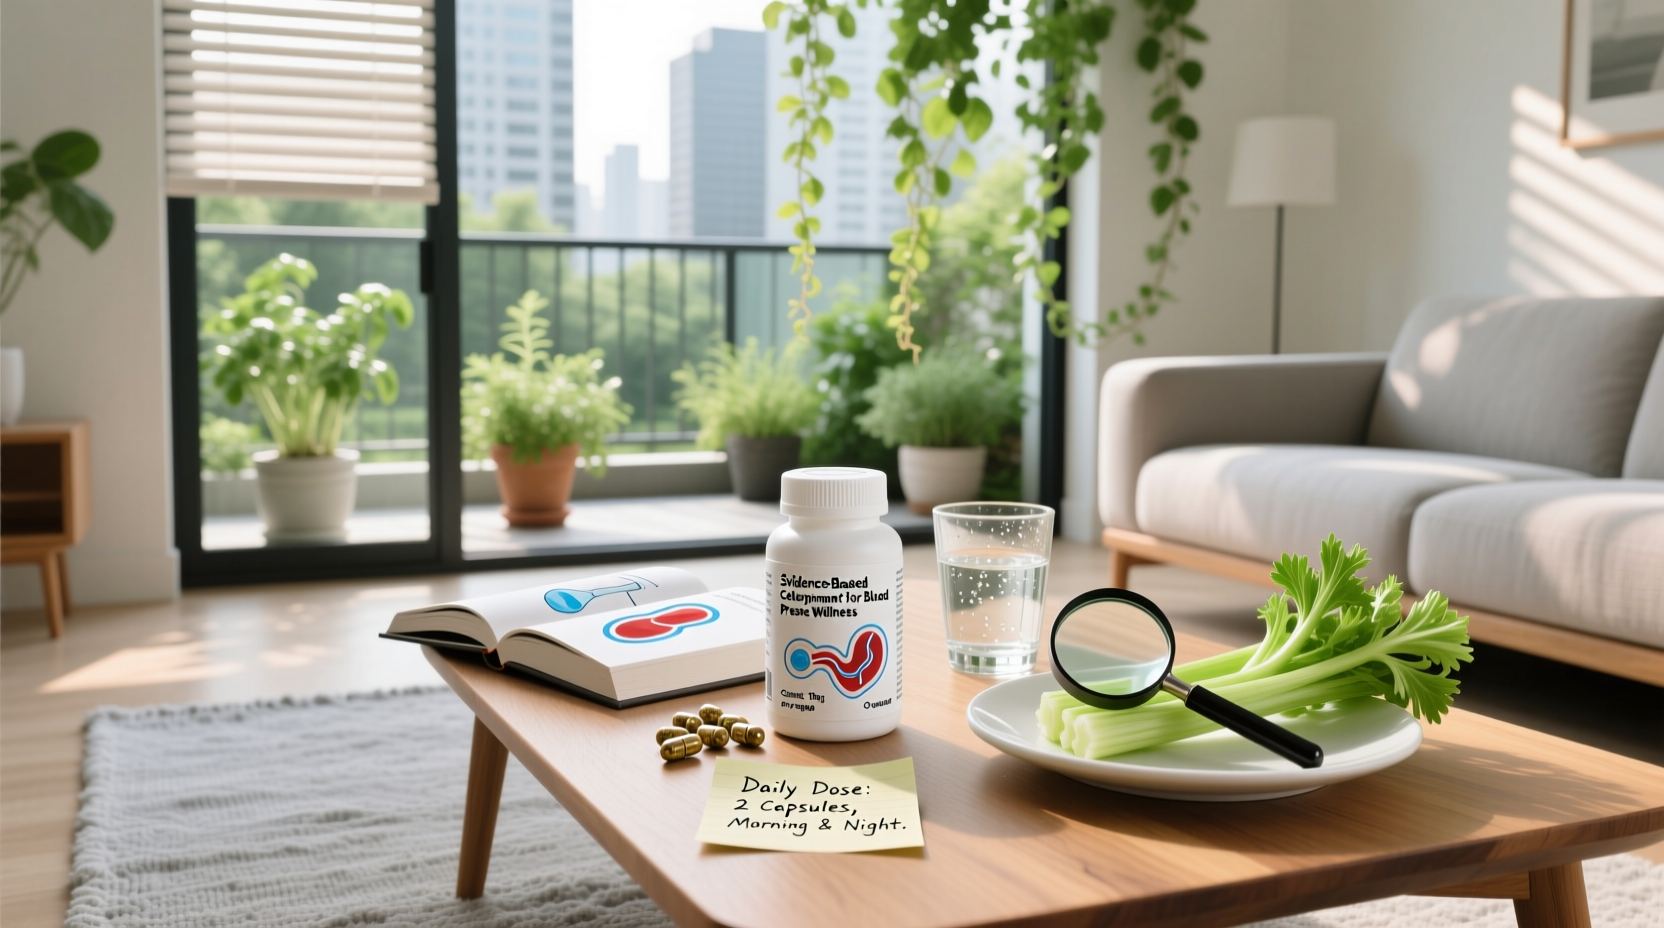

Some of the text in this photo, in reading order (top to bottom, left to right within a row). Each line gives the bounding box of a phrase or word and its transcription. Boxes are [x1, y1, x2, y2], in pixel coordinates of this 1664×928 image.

[741, 776, 870, 800] Daily Dose:
[734, 799, 858, 817] 2 Capsules,
[727, 817, 907, 837] Morning & Night.
